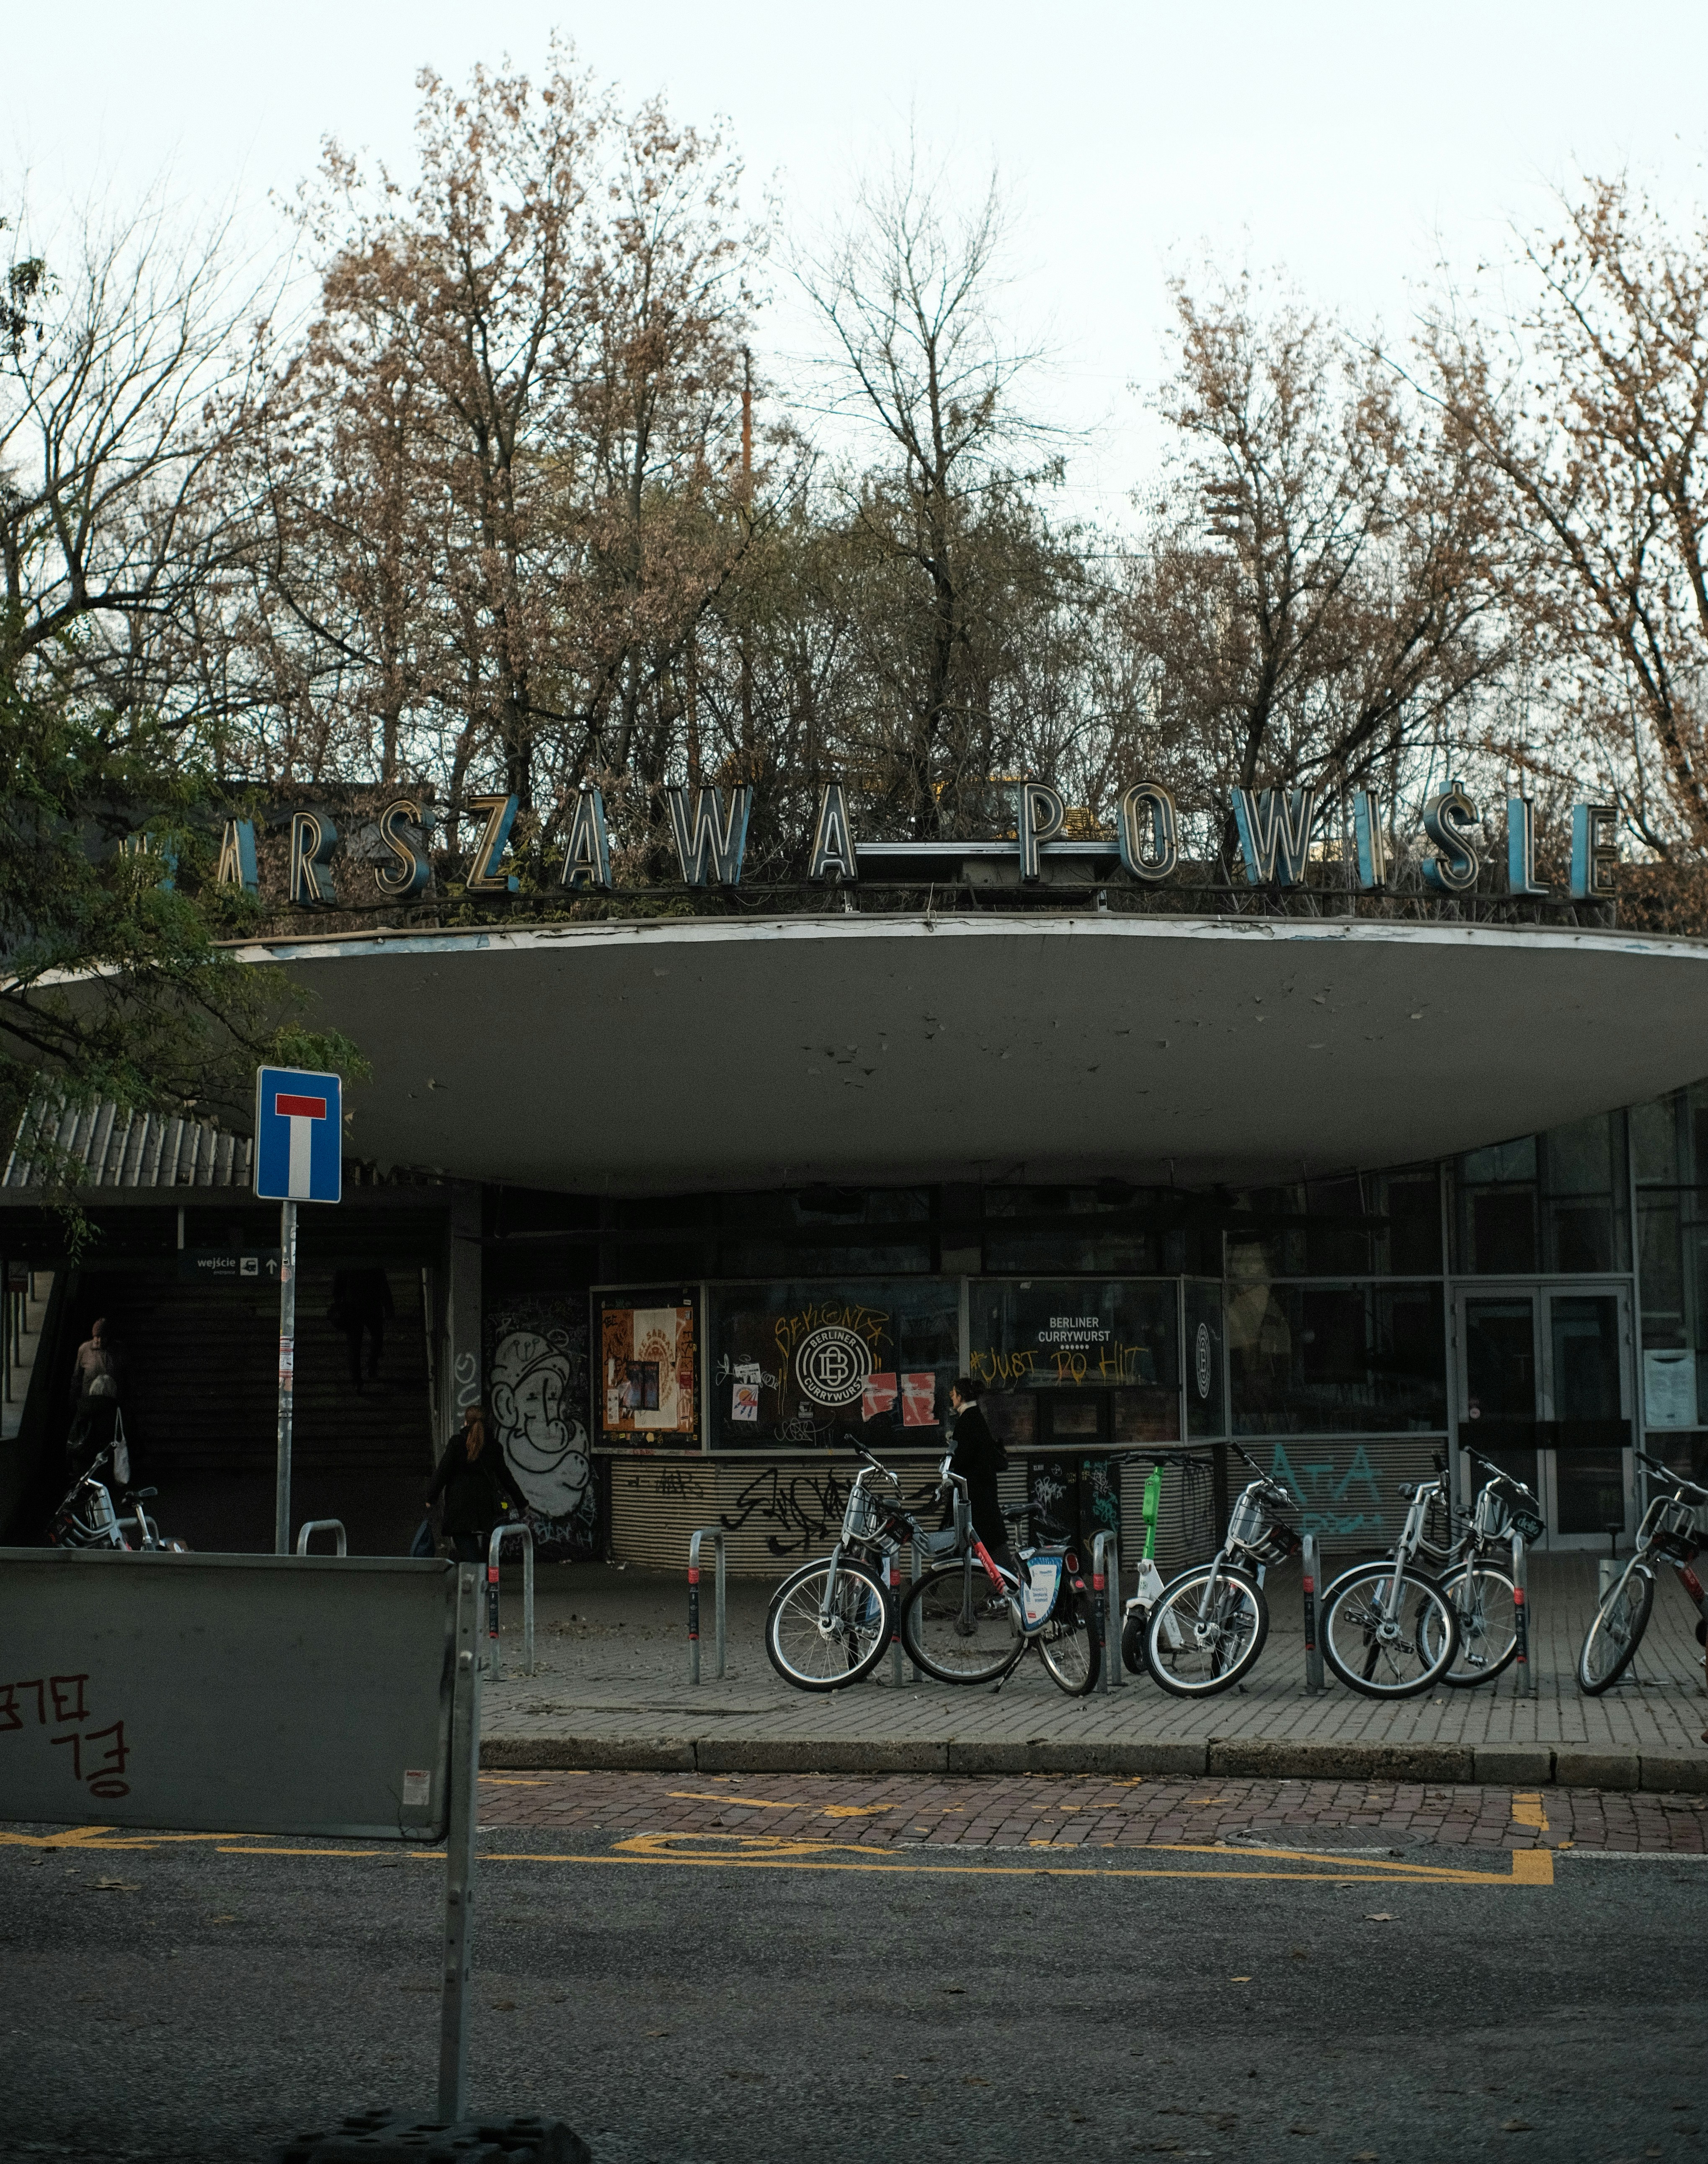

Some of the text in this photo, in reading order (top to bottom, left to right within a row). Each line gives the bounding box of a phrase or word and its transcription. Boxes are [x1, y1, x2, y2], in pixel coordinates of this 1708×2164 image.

[197, 1257, 236, 1269] wejście
[1050, 1318, 1099, 1328] BERLINER
[809, 1331, 857, 1348] BERLINER
[1038, 1331, 1110, 1342] CURRYWURST
[1051, 1351, 1087, 1380] DO
[803, 1375, 863, 1402] CURRYWURST
[977, 1550, 994, 1579] ETURILO
